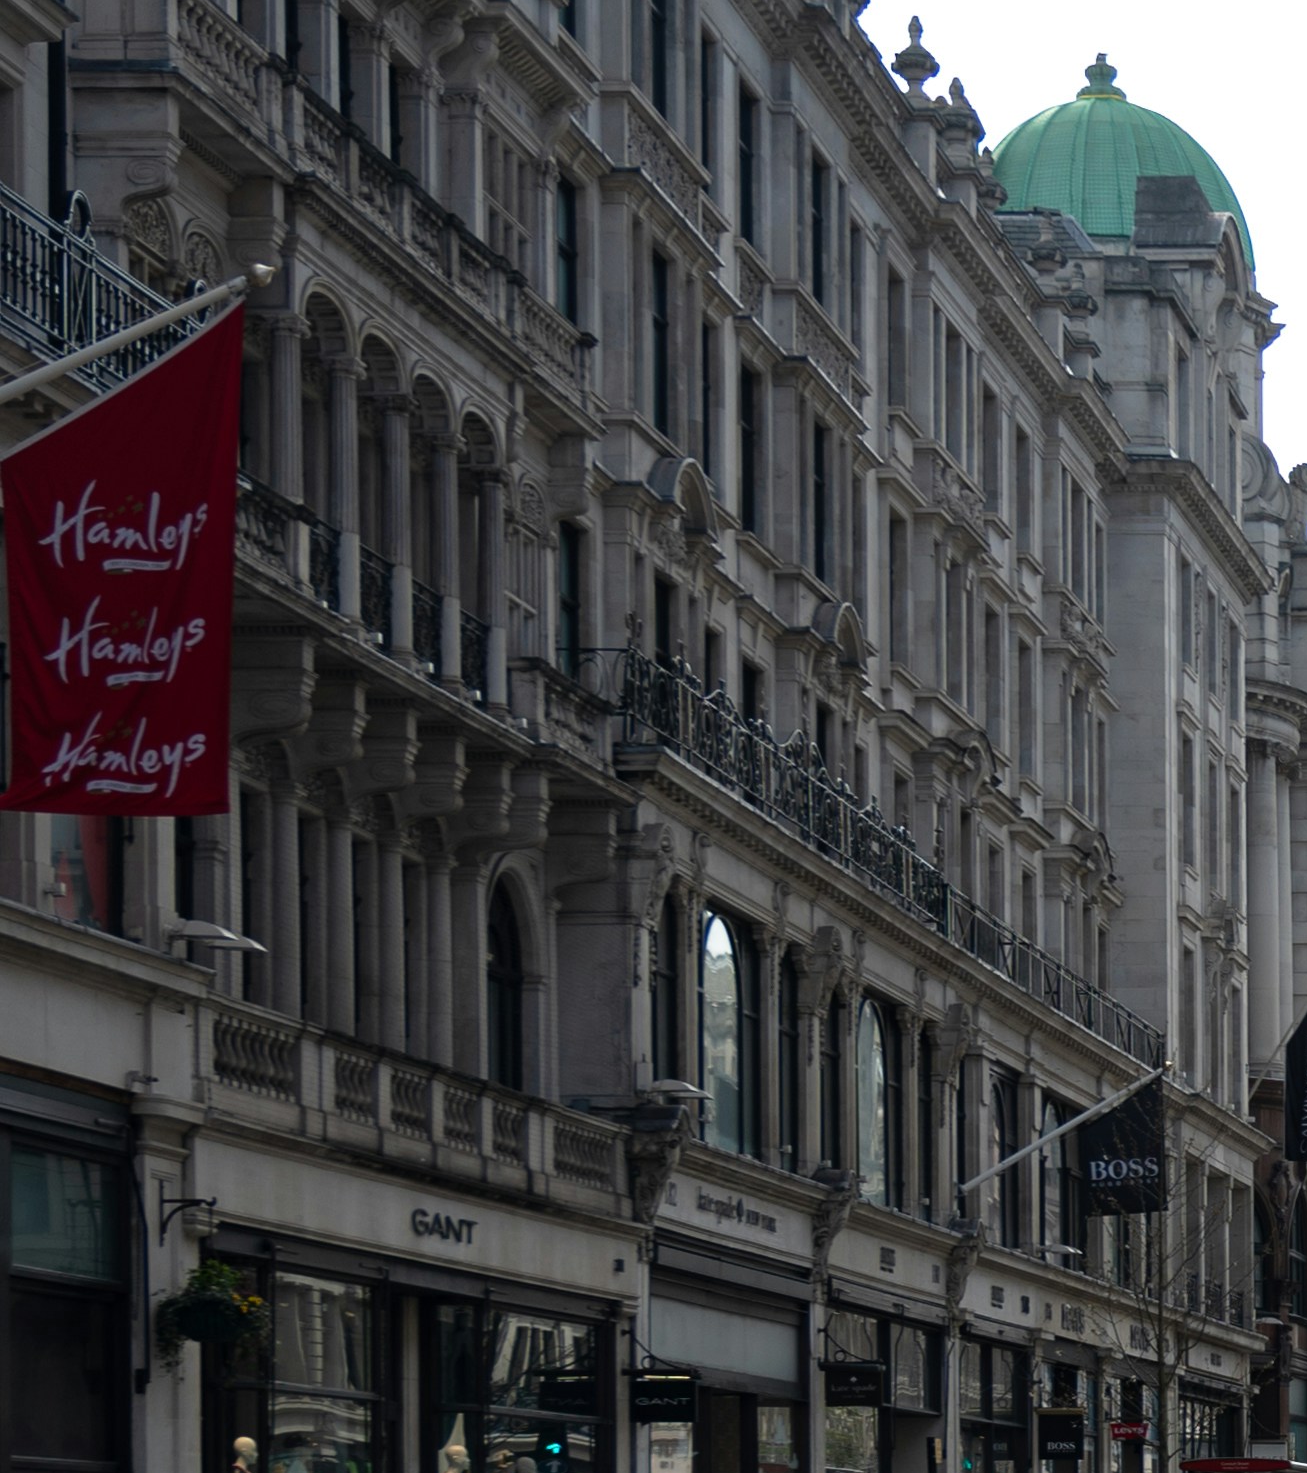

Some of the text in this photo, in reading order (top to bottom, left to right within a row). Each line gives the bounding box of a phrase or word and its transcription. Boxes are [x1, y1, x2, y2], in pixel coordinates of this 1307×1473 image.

[38, 479, 208, 571] Hamleys
[43, 594, 207, 683] Hamleys
[41, 710, 207, 798] Hamleys
[1089, 1157, 1159, 1181] BOSS
[411, 1208, 478, 1244] GANT
[635, 1397, 691, 1406] GANT
[1047, 1441, 1076, 1450] BOSS
